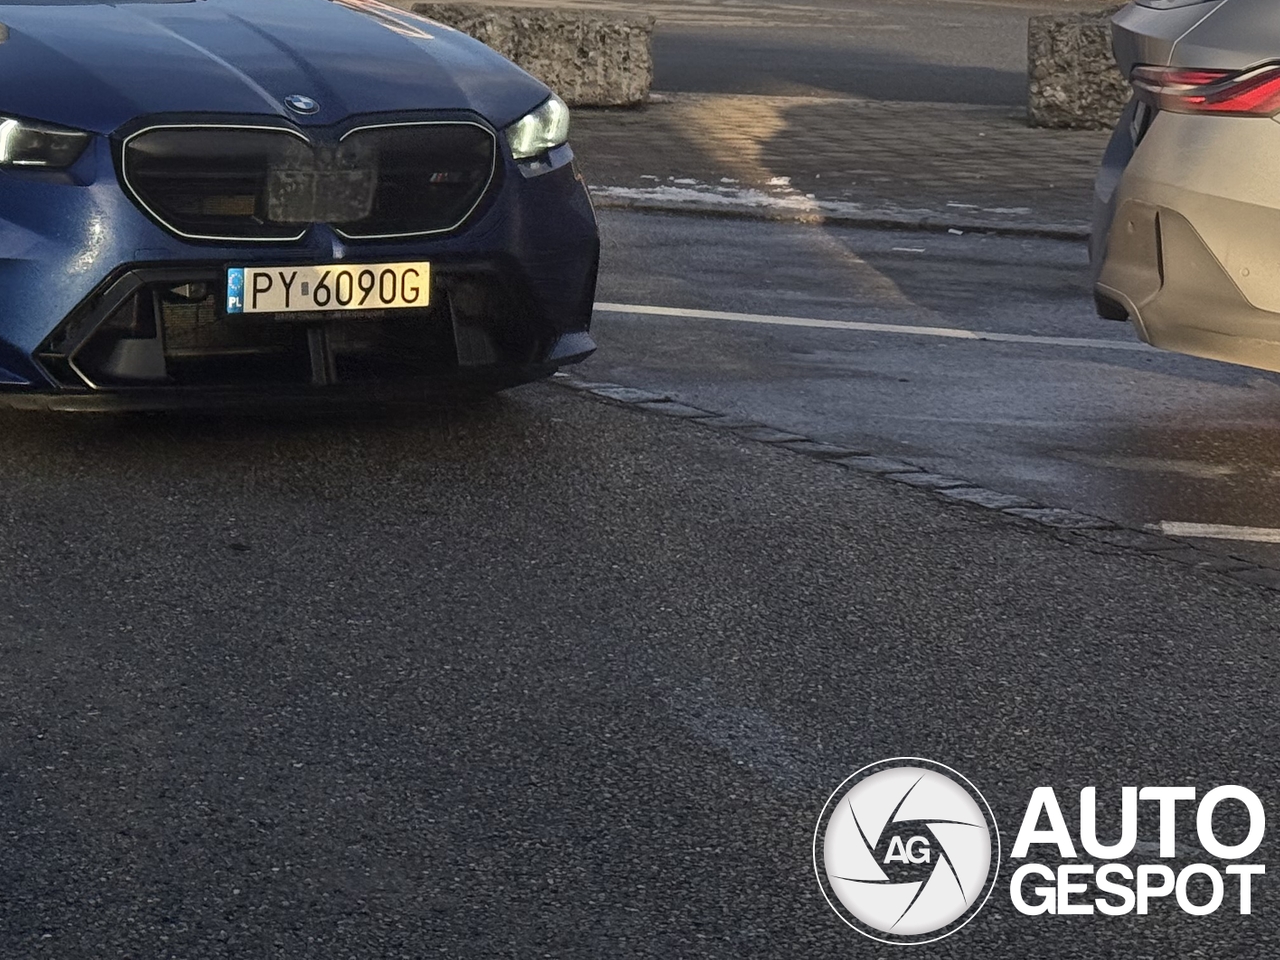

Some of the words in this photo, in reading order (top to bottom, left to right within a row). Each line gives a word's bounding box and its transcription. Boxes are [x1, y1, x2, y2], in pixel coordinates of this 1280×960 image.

[228, 296, 242, 308] PL
[252, 271, 298, 309] PY
[313, 268, 420, 307] 6090G
